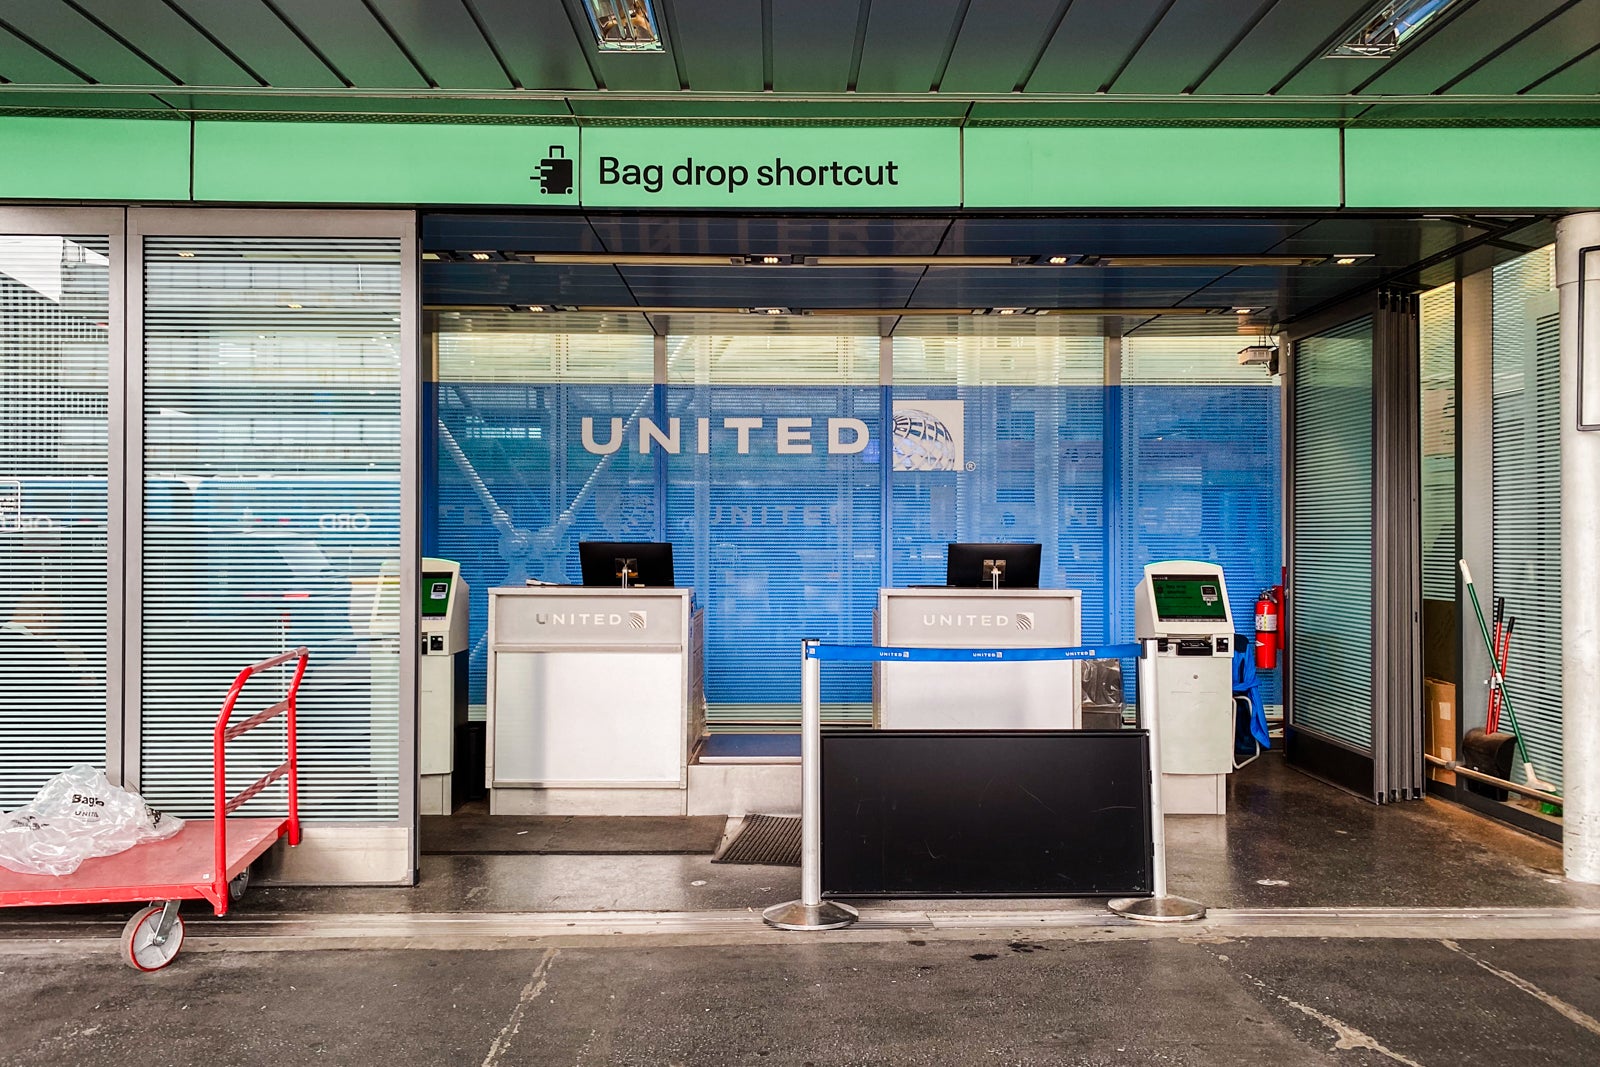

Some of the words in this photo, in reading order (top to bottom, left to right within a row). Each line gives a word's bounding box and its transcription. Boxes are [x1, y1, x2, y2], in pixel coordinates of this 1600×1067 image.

[600, 156, 663, 193] Bag
[672, 157, 749, 193] drop
[757, 157, 899, 186] shortcut
[581, 416, 870, 455] UNITED
[536, 613, 622, 625] UNITED
[923, 614, 1009, 626] UNITED
